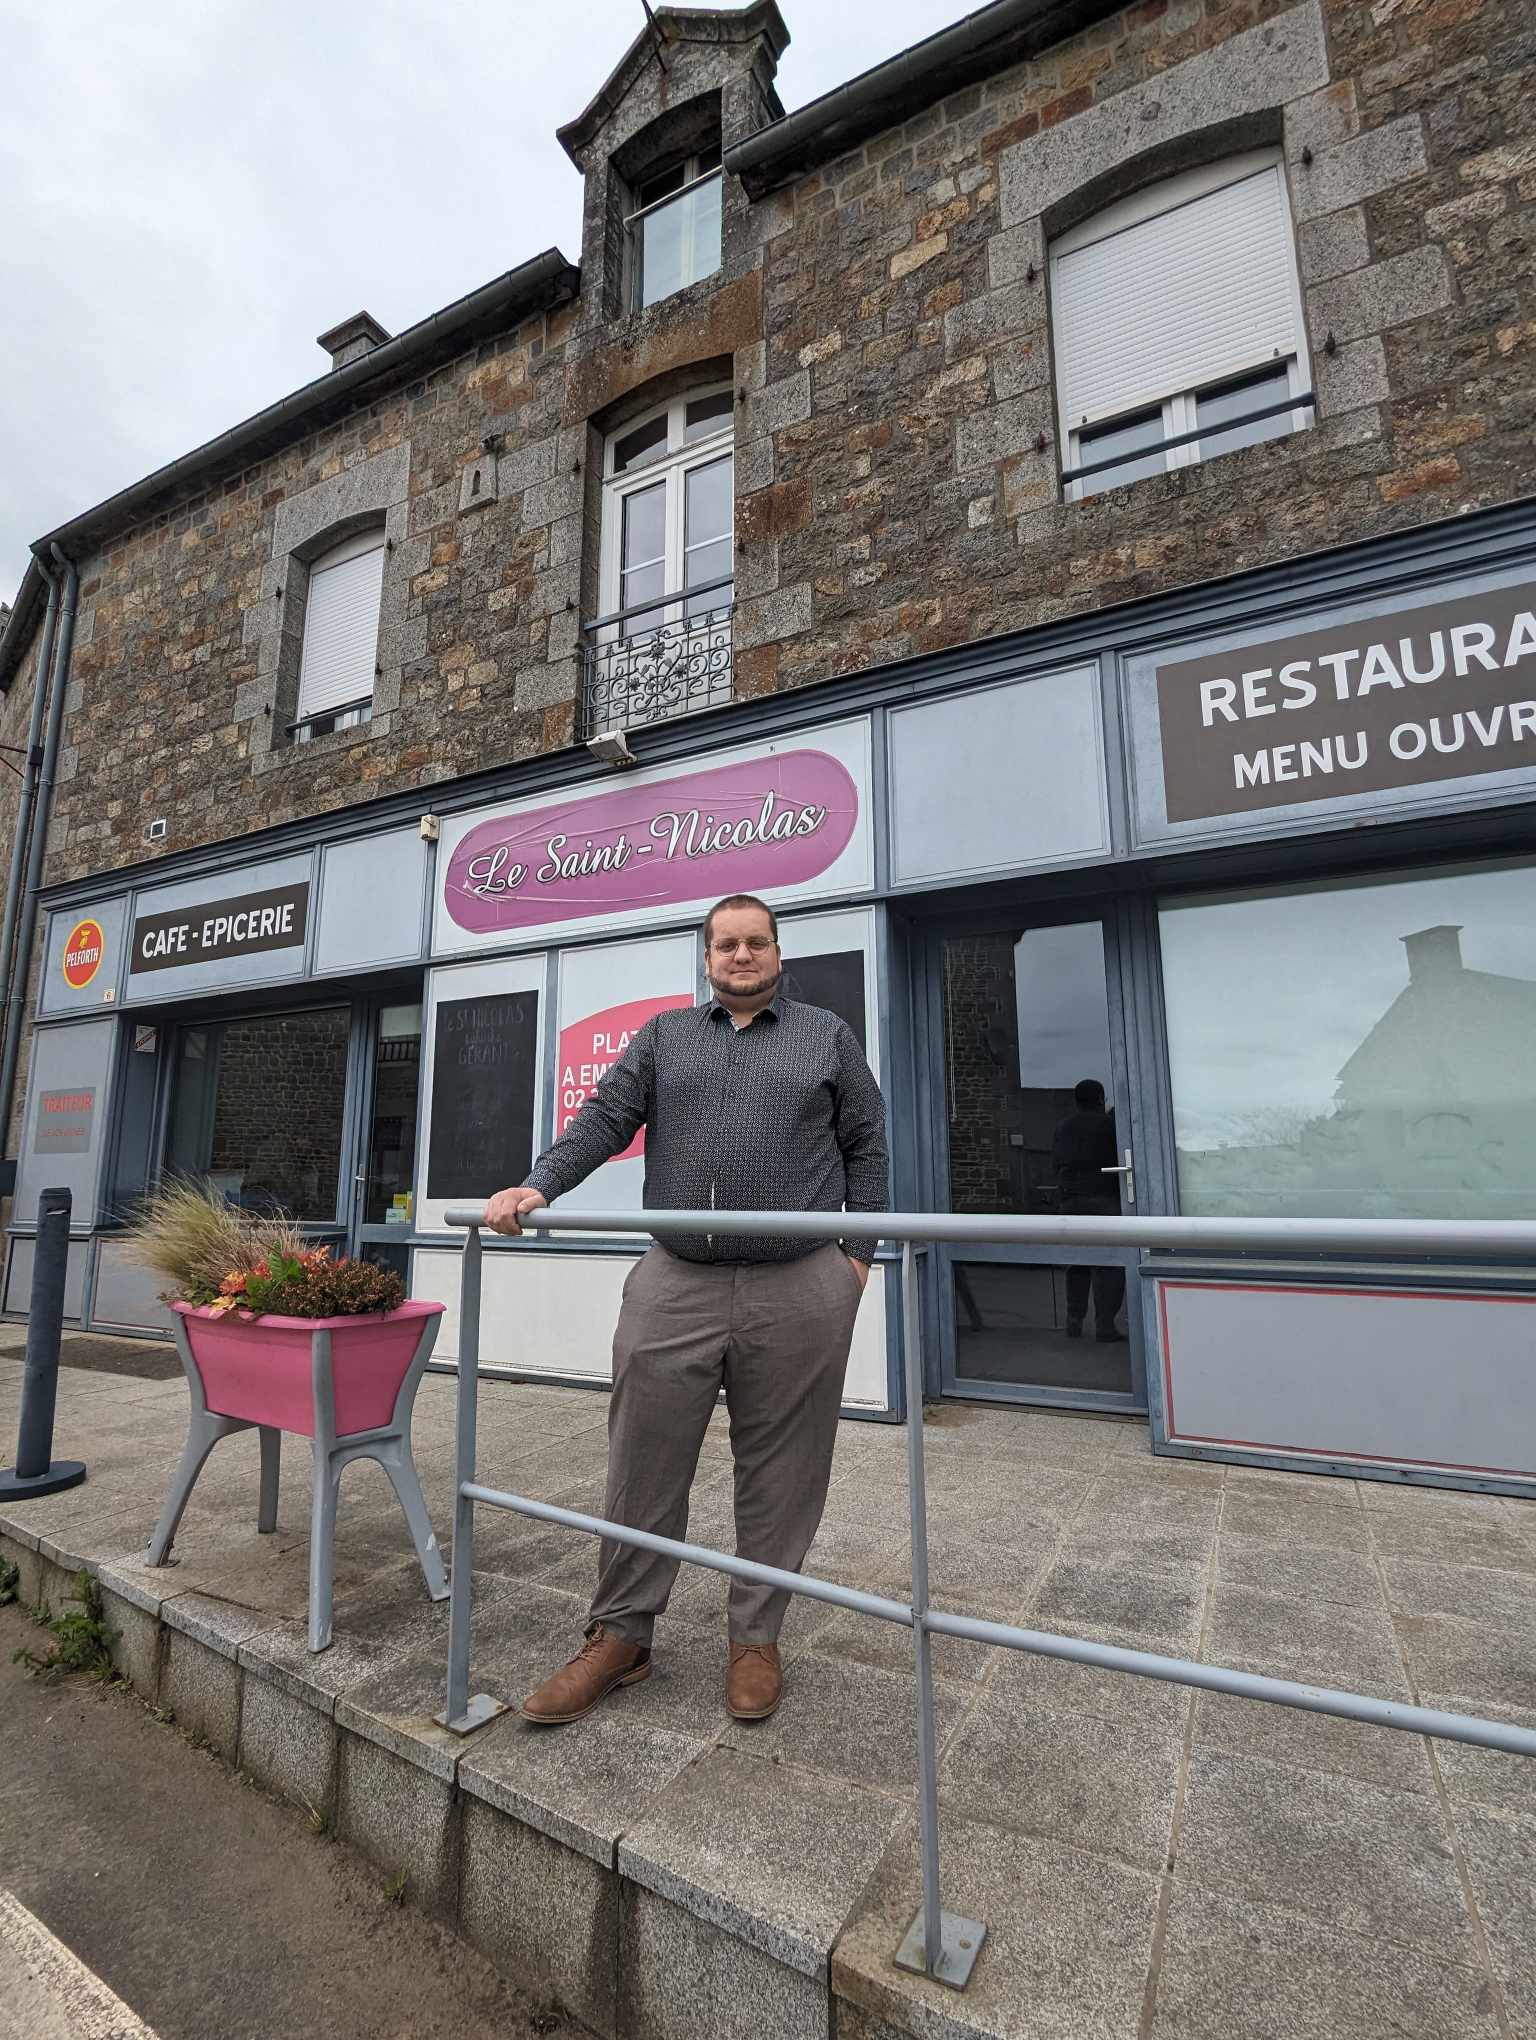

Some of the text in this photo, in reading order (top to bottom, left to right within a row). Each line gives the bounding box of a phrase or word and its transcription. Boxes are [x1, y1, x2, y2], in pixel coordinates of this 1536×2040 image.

[1200, 612, 1536, 727] RESTAURA
[1233, 701, 1536, 789] MENU OUVR
[466, 847, 527, 894] Le
[66, 947, 99, 968] PELFORTH
[593, 1031, 639, 1056] PLA
[562, 1066, 575, 1088] A
